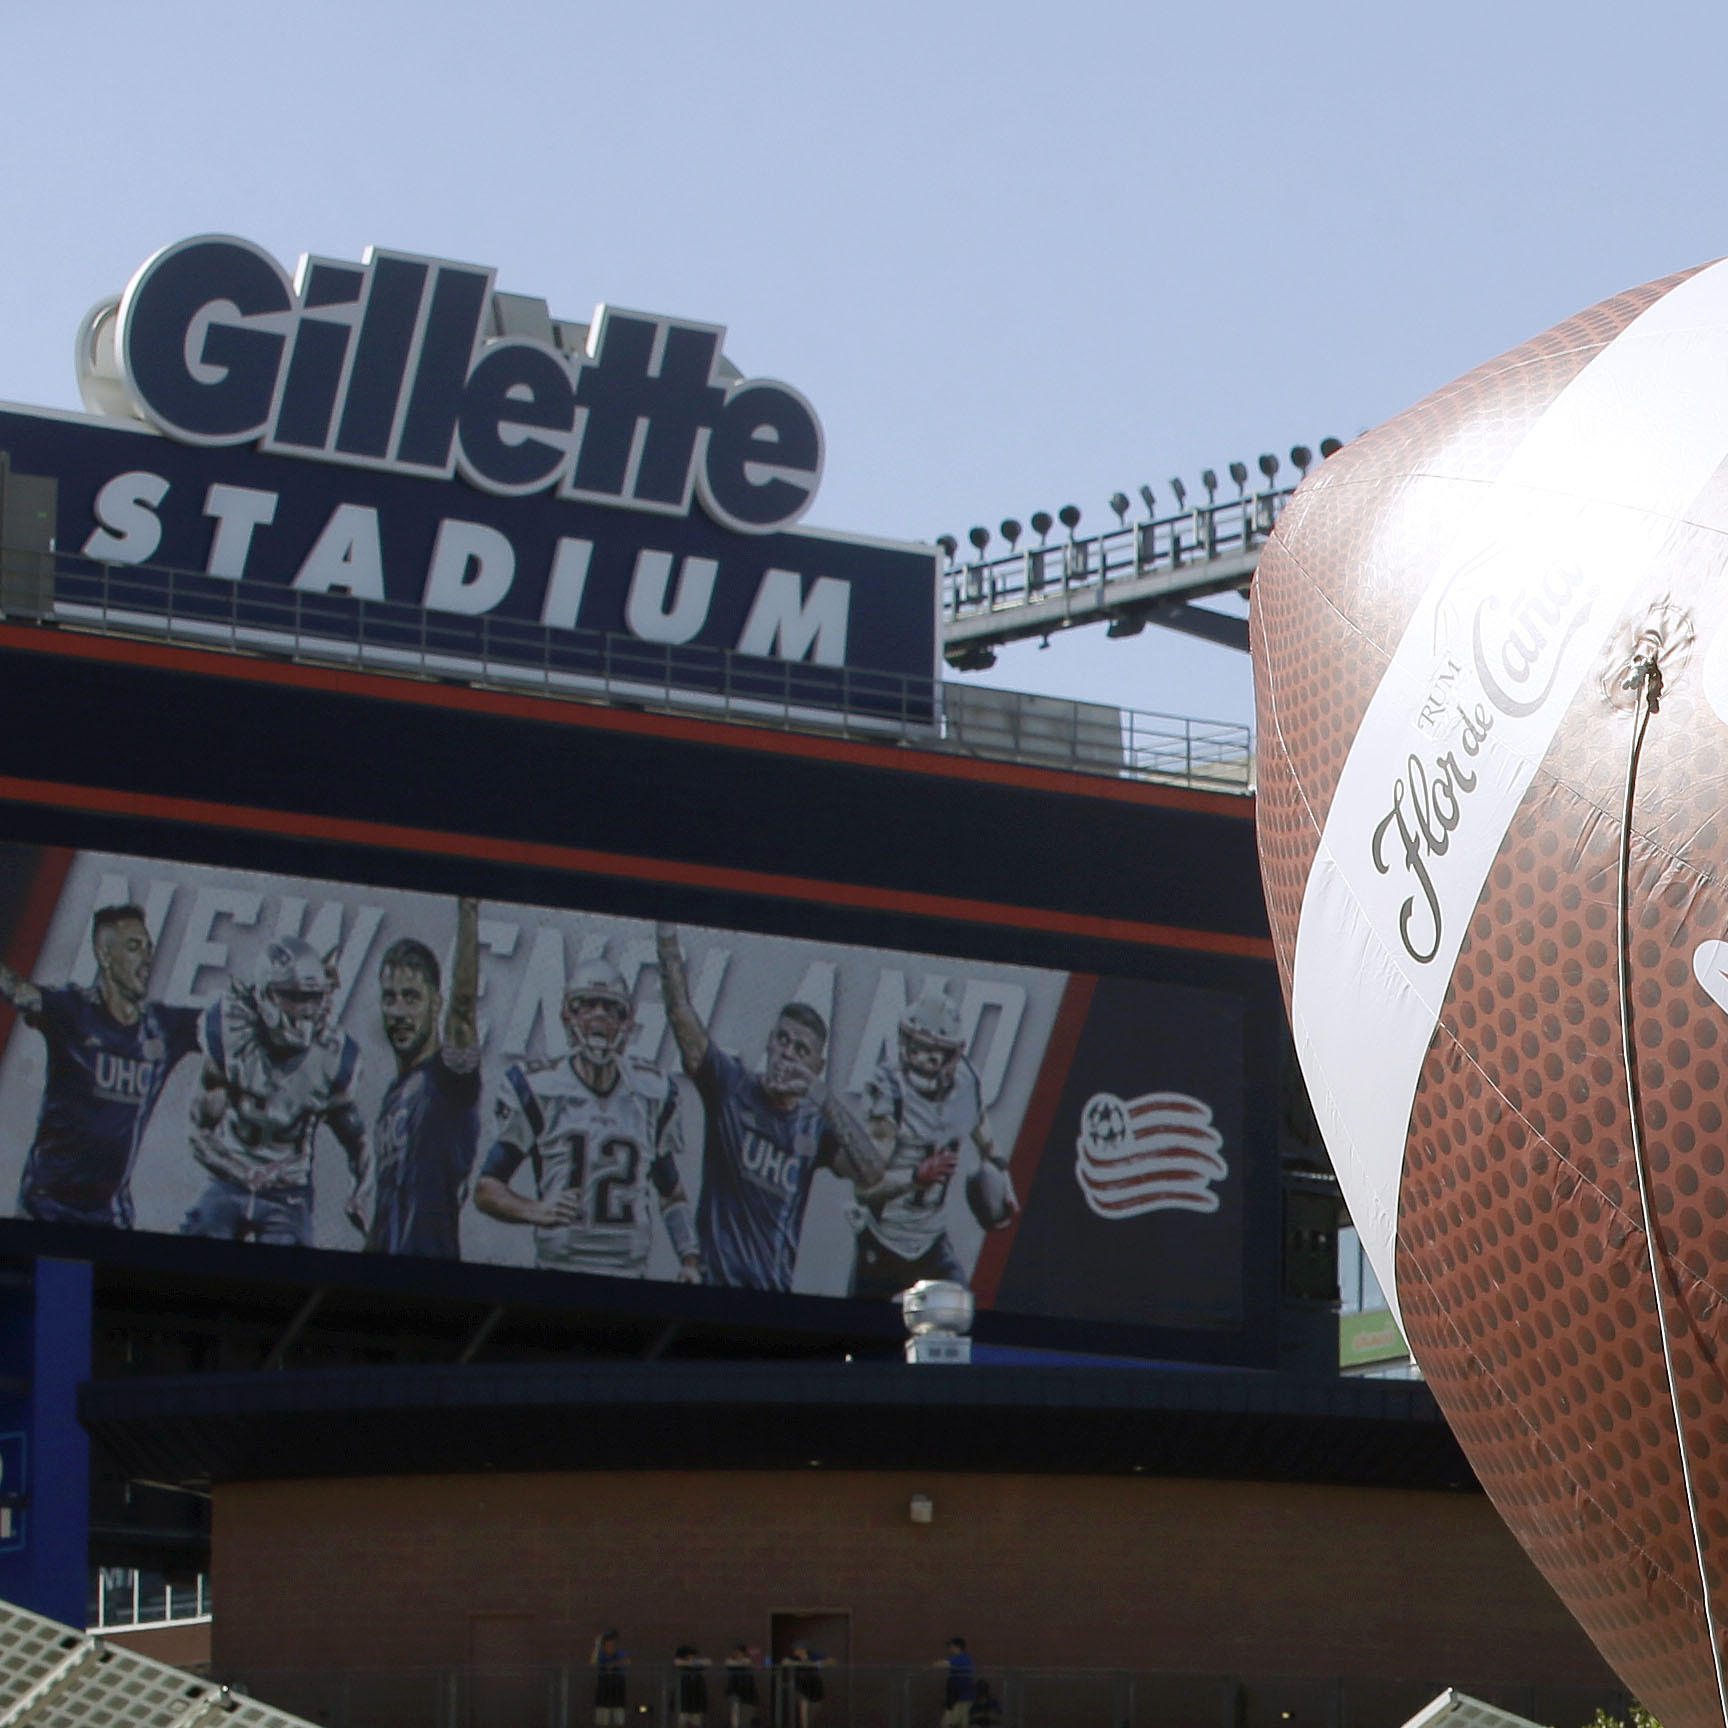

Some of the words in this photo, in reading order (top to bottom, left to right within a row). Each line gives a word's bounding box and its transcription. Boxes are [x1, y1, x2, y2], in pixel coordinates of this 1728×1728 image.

[115, 233, 825, 534] Gillette
[83, 471, 851, 669] STADIUM
[1418, 658, 1461, 734] RUM
[1372, 754, 1477, 964] Flor
[1457, 701, 1494, 757] de
[566, 1129, 639, 1227] 12
